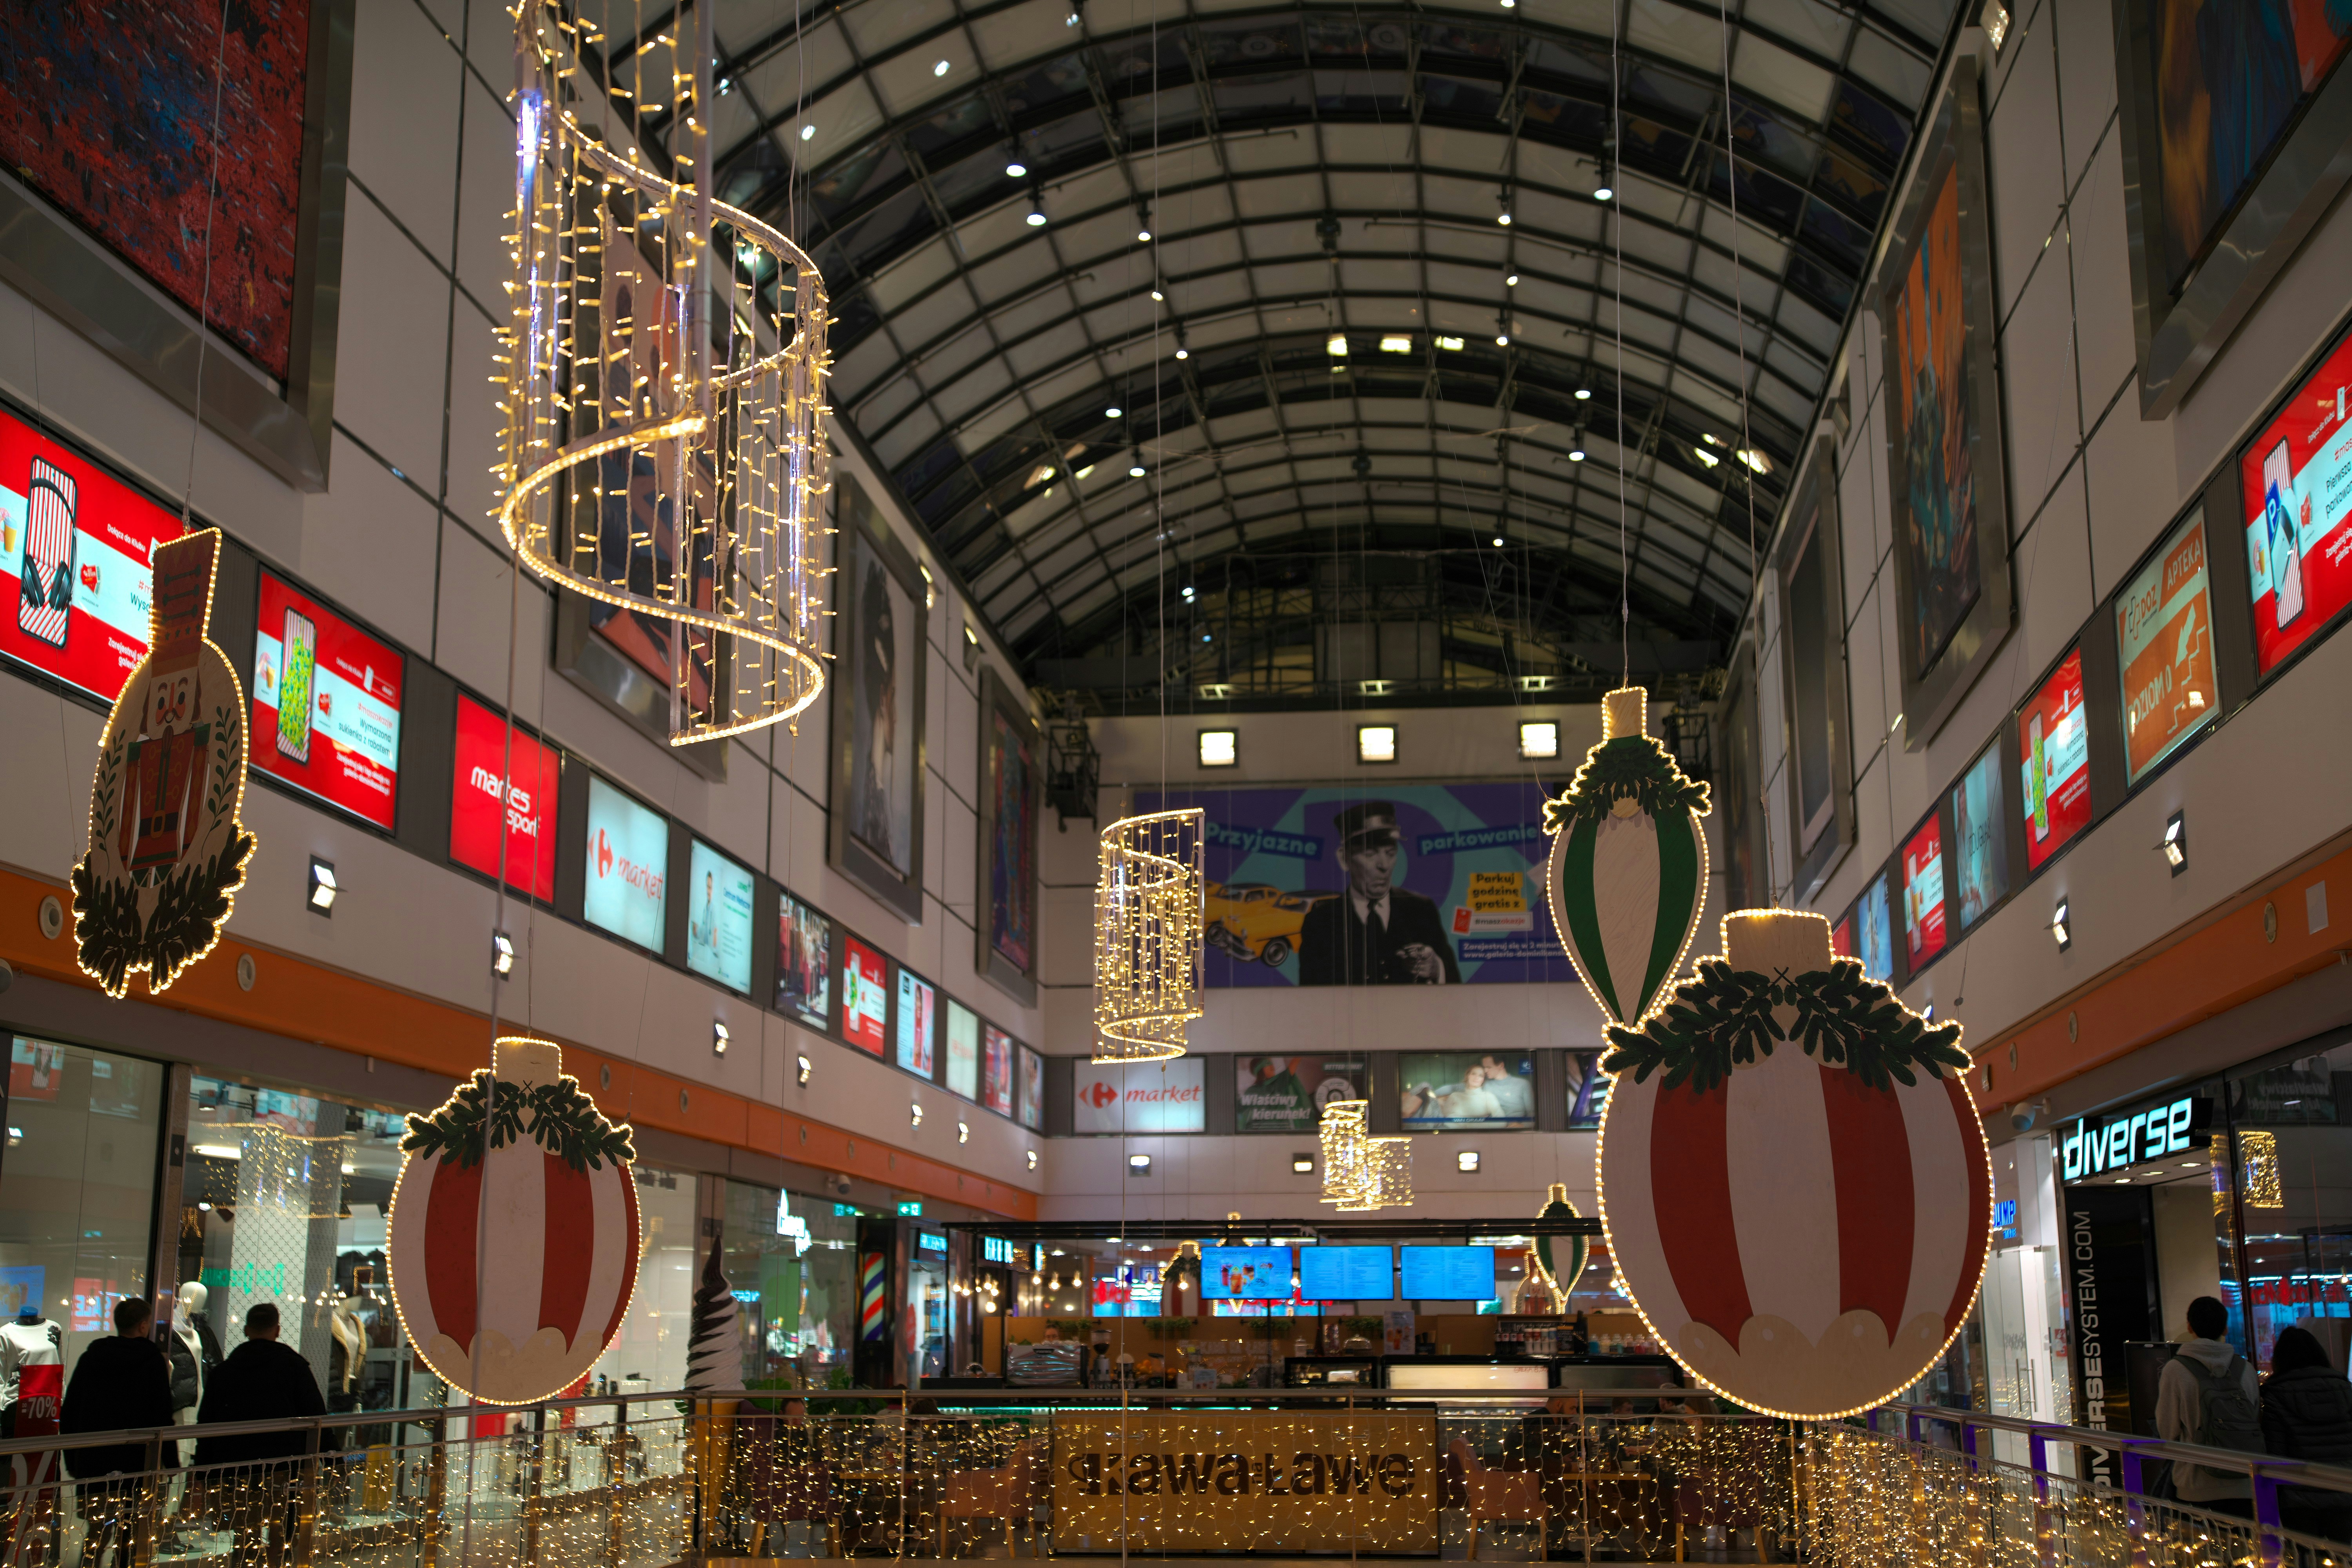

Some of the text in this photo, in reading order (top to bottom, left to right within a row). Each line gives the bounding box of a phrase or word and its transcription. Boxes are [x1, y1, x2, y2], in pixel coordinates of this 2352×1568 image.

[2319, 421, 2325, 431] do
[2325, 410, 2335, 425] Klubu
[2335, 437, 2352, 462] #mas
[2327, 460, 2352, 493] Pierwsza
[107, 523, 146, 553] Dołącz do Klubu
[2167, 537, 2201, 590] APTEKA
[2141, 584, 2157, 619] DOZ
[108, 636, 137, 661] Zarejestruj
[2128, 671, 2165, 733] POZIOM
[338, 722, 362, 742] sukienka
[367, 739, 391, 757] rabatem
[359, 717, 391, 743] Wymarzona
[2066, 730, 2084, 753] Wymarzona
[471, 766, 531, 814] martes
[506, 808, 540, 838] sport
[1205, 822, 1318, 856] Przyjazne
[1421, 822, 1537, 855] parkowanie
[1969, 817, 1991, 857] DOUGLAS
[617, 855, 663, 900] market
[1476, 873, 1515, 885] Parkuj
[1473, 886, 1519, 898] godzinę
[1475, 899, 1510, 911] gratis
[1475, 918, 1525, 926] #maszokazje
[1464, 942, 1507, 952] Zarejestruj
[1510, 942, 1520, 950] się
[1125, 1085, 1203, 1104] market
[1241, 1094, 1299, 1107] Właściwy
[1252, 1108, 1311, 1120] kierunek!
[2063, 1098, 2192, 1181] diverse
[1118, 1266, 1131, 1281] P
